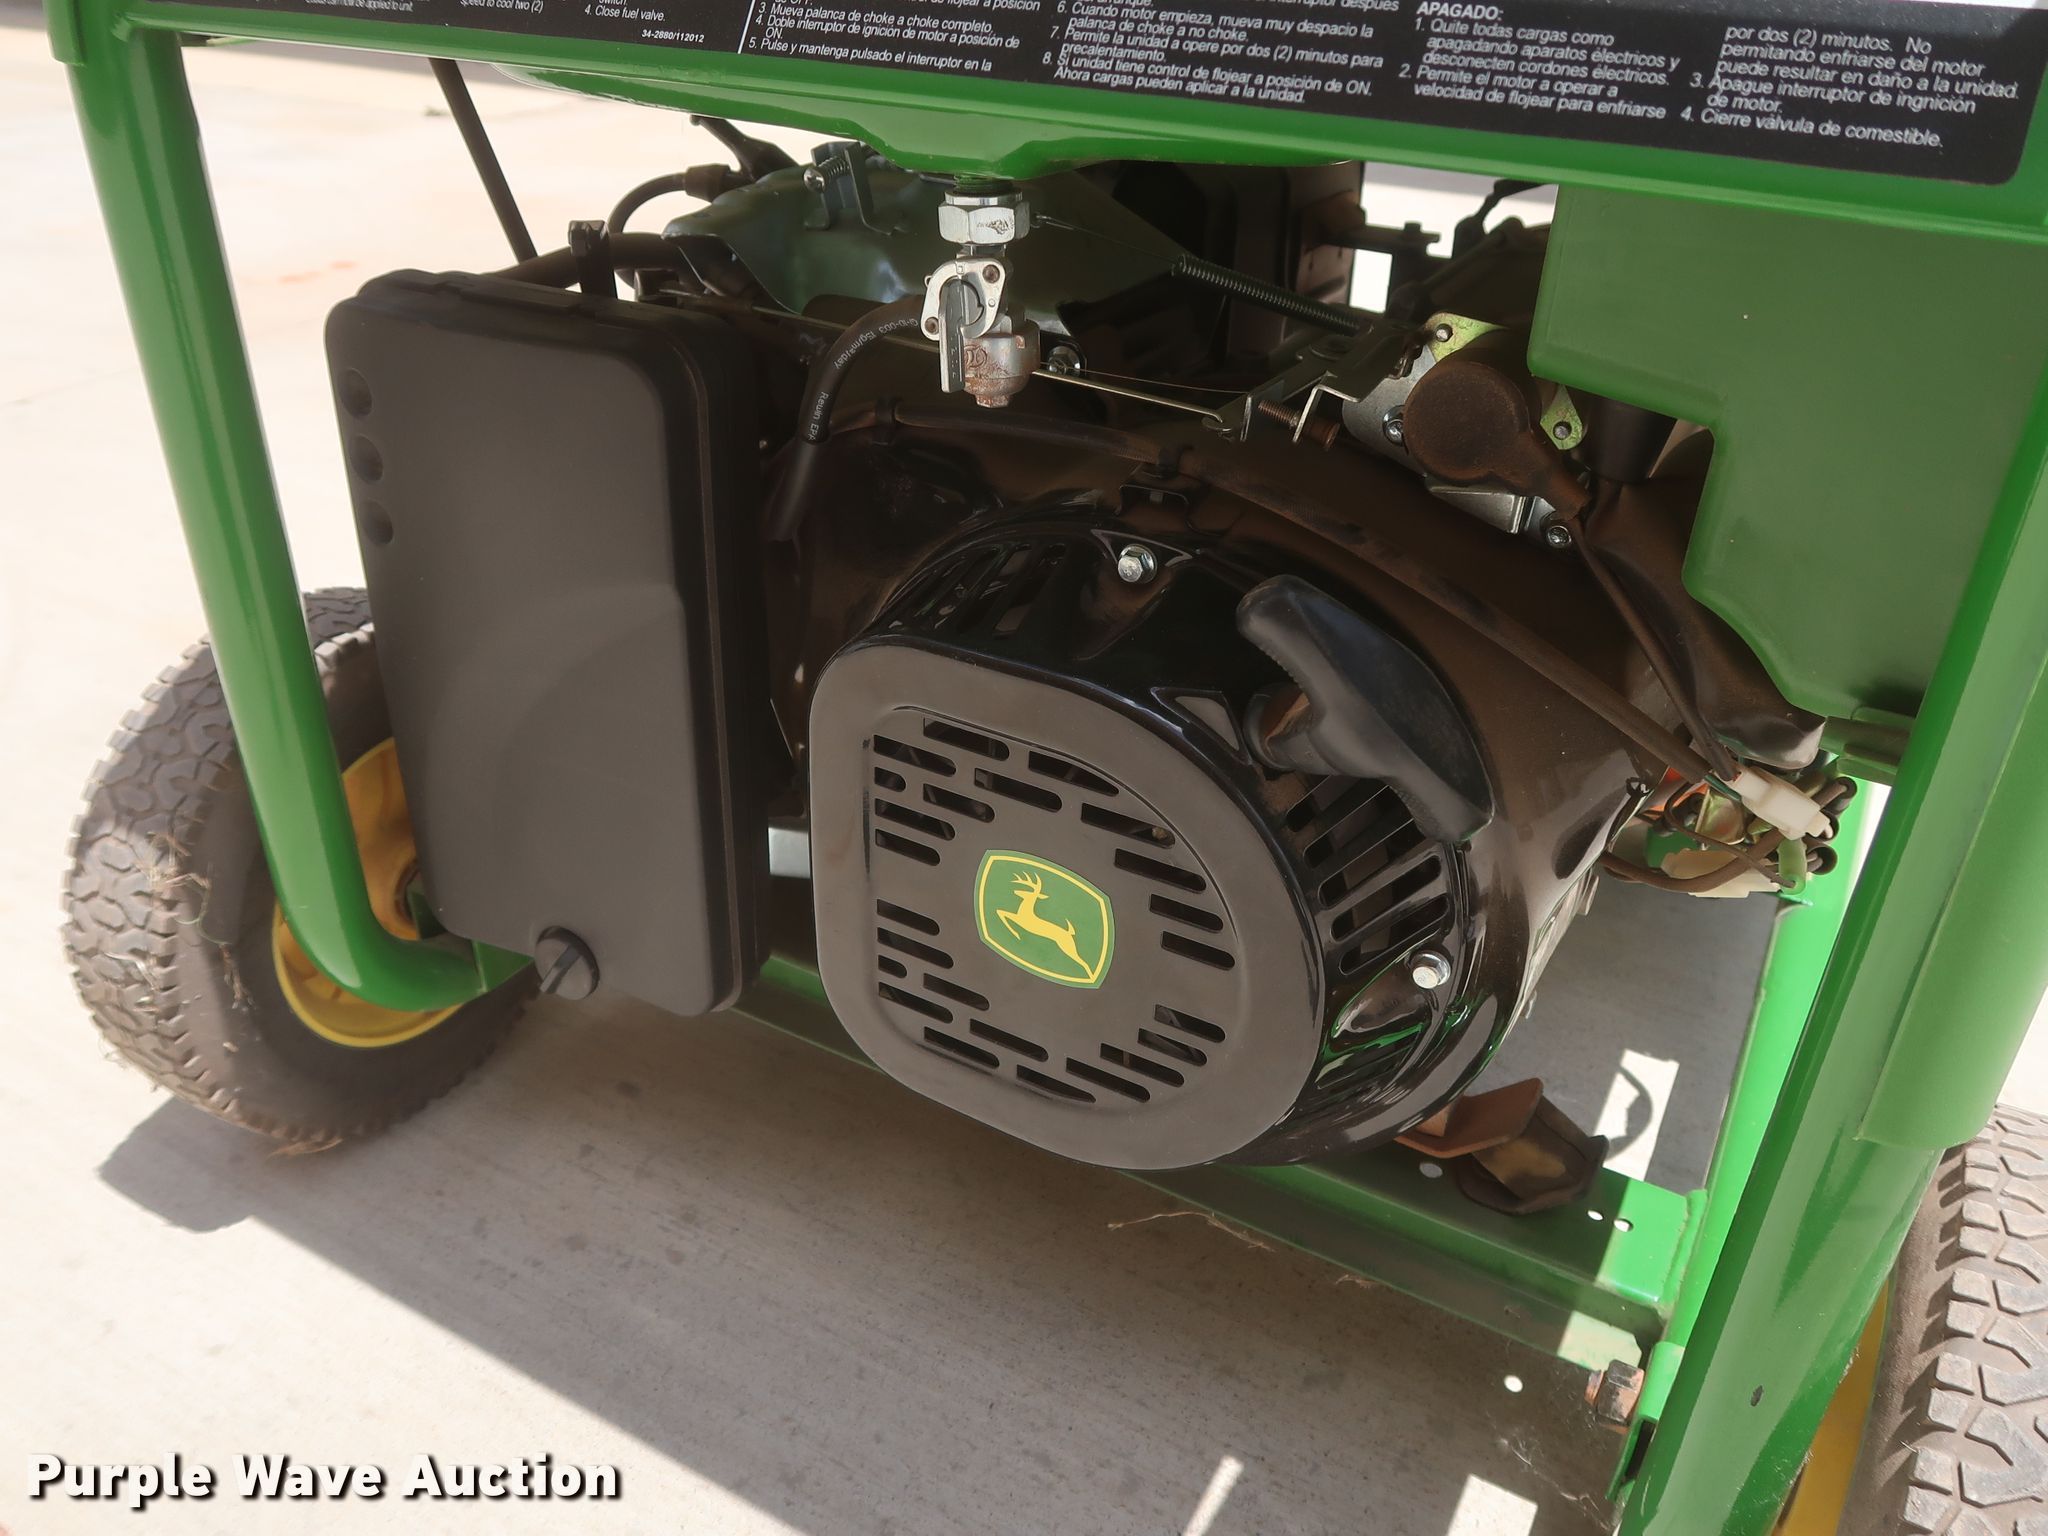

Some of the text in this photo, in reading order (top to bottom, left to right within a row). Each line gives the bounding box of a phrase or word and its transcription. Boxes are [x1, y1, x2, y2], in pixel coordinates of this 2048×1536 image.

[531, 1, 544, 14] (2)
[585, 6, 666, 21] 4. Close fuel valve.
[758, 2, 767, 12] 3.
[770, 3, 804, 17] Mueva
[805, 8, 846, 23] palanca
[848, 10, 861, 21] de
[863, 11, 895, 24] choke
[897, 15, 904, 24] a
[907, 15, 939, 28] choke
[1057, 1, 1068, 12] 6.
[1072, 2, 1119, 15] Cuando
[1122, 7, 1158, 19] motor
[1219, 15, 1262, 27] mueva
[1265, 19, 1294, 33] muy
[1297, 20, 1358, 36] despacio
[1361, 24, 1373, 37] la
[1416, 2, 1503, 20] APAGADO:
[755, 15, 764, 25] 4.
[767, 14, 796, 29] Doble
[796, 18, 846, 36] interruptor
[848, 21, 861, 33] de
[901, 26, 915, 37] de
[918, 28, 947, 41] motor
[949, 33, 957, 41] a
[1005, 36, 1020, 48] de
[766, 27, 783, 38] ON.
[1068, 16, 1248, 40] palanca de choke a no choke.
[1415, 18, 1615, 45] 1. Quite todas cargas como
[1724, 27, 1932, 55] por dos (2) minutos. No
[749, 38, 992, 71] 5. Pulse y mantenga pulsado el interruptor en la
[1050, 25, 1384, 68] 7. Permite la unidad a opere por dos (2) minutos para
[1520, 42, 1587, 60] aparatos
[1668, 57, 1681, 71] y
[1042, 51, 1053, 63] 8.
[1072, 53, 1114, 69] unidad
[1115, 57, 1145, 72] tiene
[1148, 60, 1191, 75] control
[1193, 64, 1210, 77] de
[1254, 73, 1264, 83] a
[1324, 77, 1342, 92] de
[1346, 80, 1373, 95] ON.
[1518, 59, 1589, 77] cordones
[1715, 60, 1769, 78] puede
[1772, 64, 1838, 82] resultar
[1841, 71, 1863, 84] en
[1916, 79, 1929, 92] a
[1933, 77, 1950, 93] la
[1900, 55, 1930, 72] del
[1932, 60, 1986, 76] motor
[1054, 64, 1091, 79] Ahora
[1093, 70, 1133, 87] cargas
[1135, 73, 1184, 89] pueden
[1231, 85, 1240, 95] a
[1242, 83, 1255, 98] la
[1399, 63, 1619, 98] 2. Permite el motor a operar a
[1690, 72, 1704, 89] 3.
[1708, 78, 1773, 96] Apague
[1777, 82, 1867, 104] interruptor
[1870, 90, 1893, 105] de
[1414, 81, 1484, 100] velocidad
[1485, 89, 1505, 102] de
[1556, 98, 1593, 112] para
[1706, 92, 1782, 113] de motor.
[1680, 105, 1694, 122] 4.
[1701, 108, 1751, 127] Cierre
[1819, 119, 1842, 137] de
[813, 391, 829, 420] Rewin
